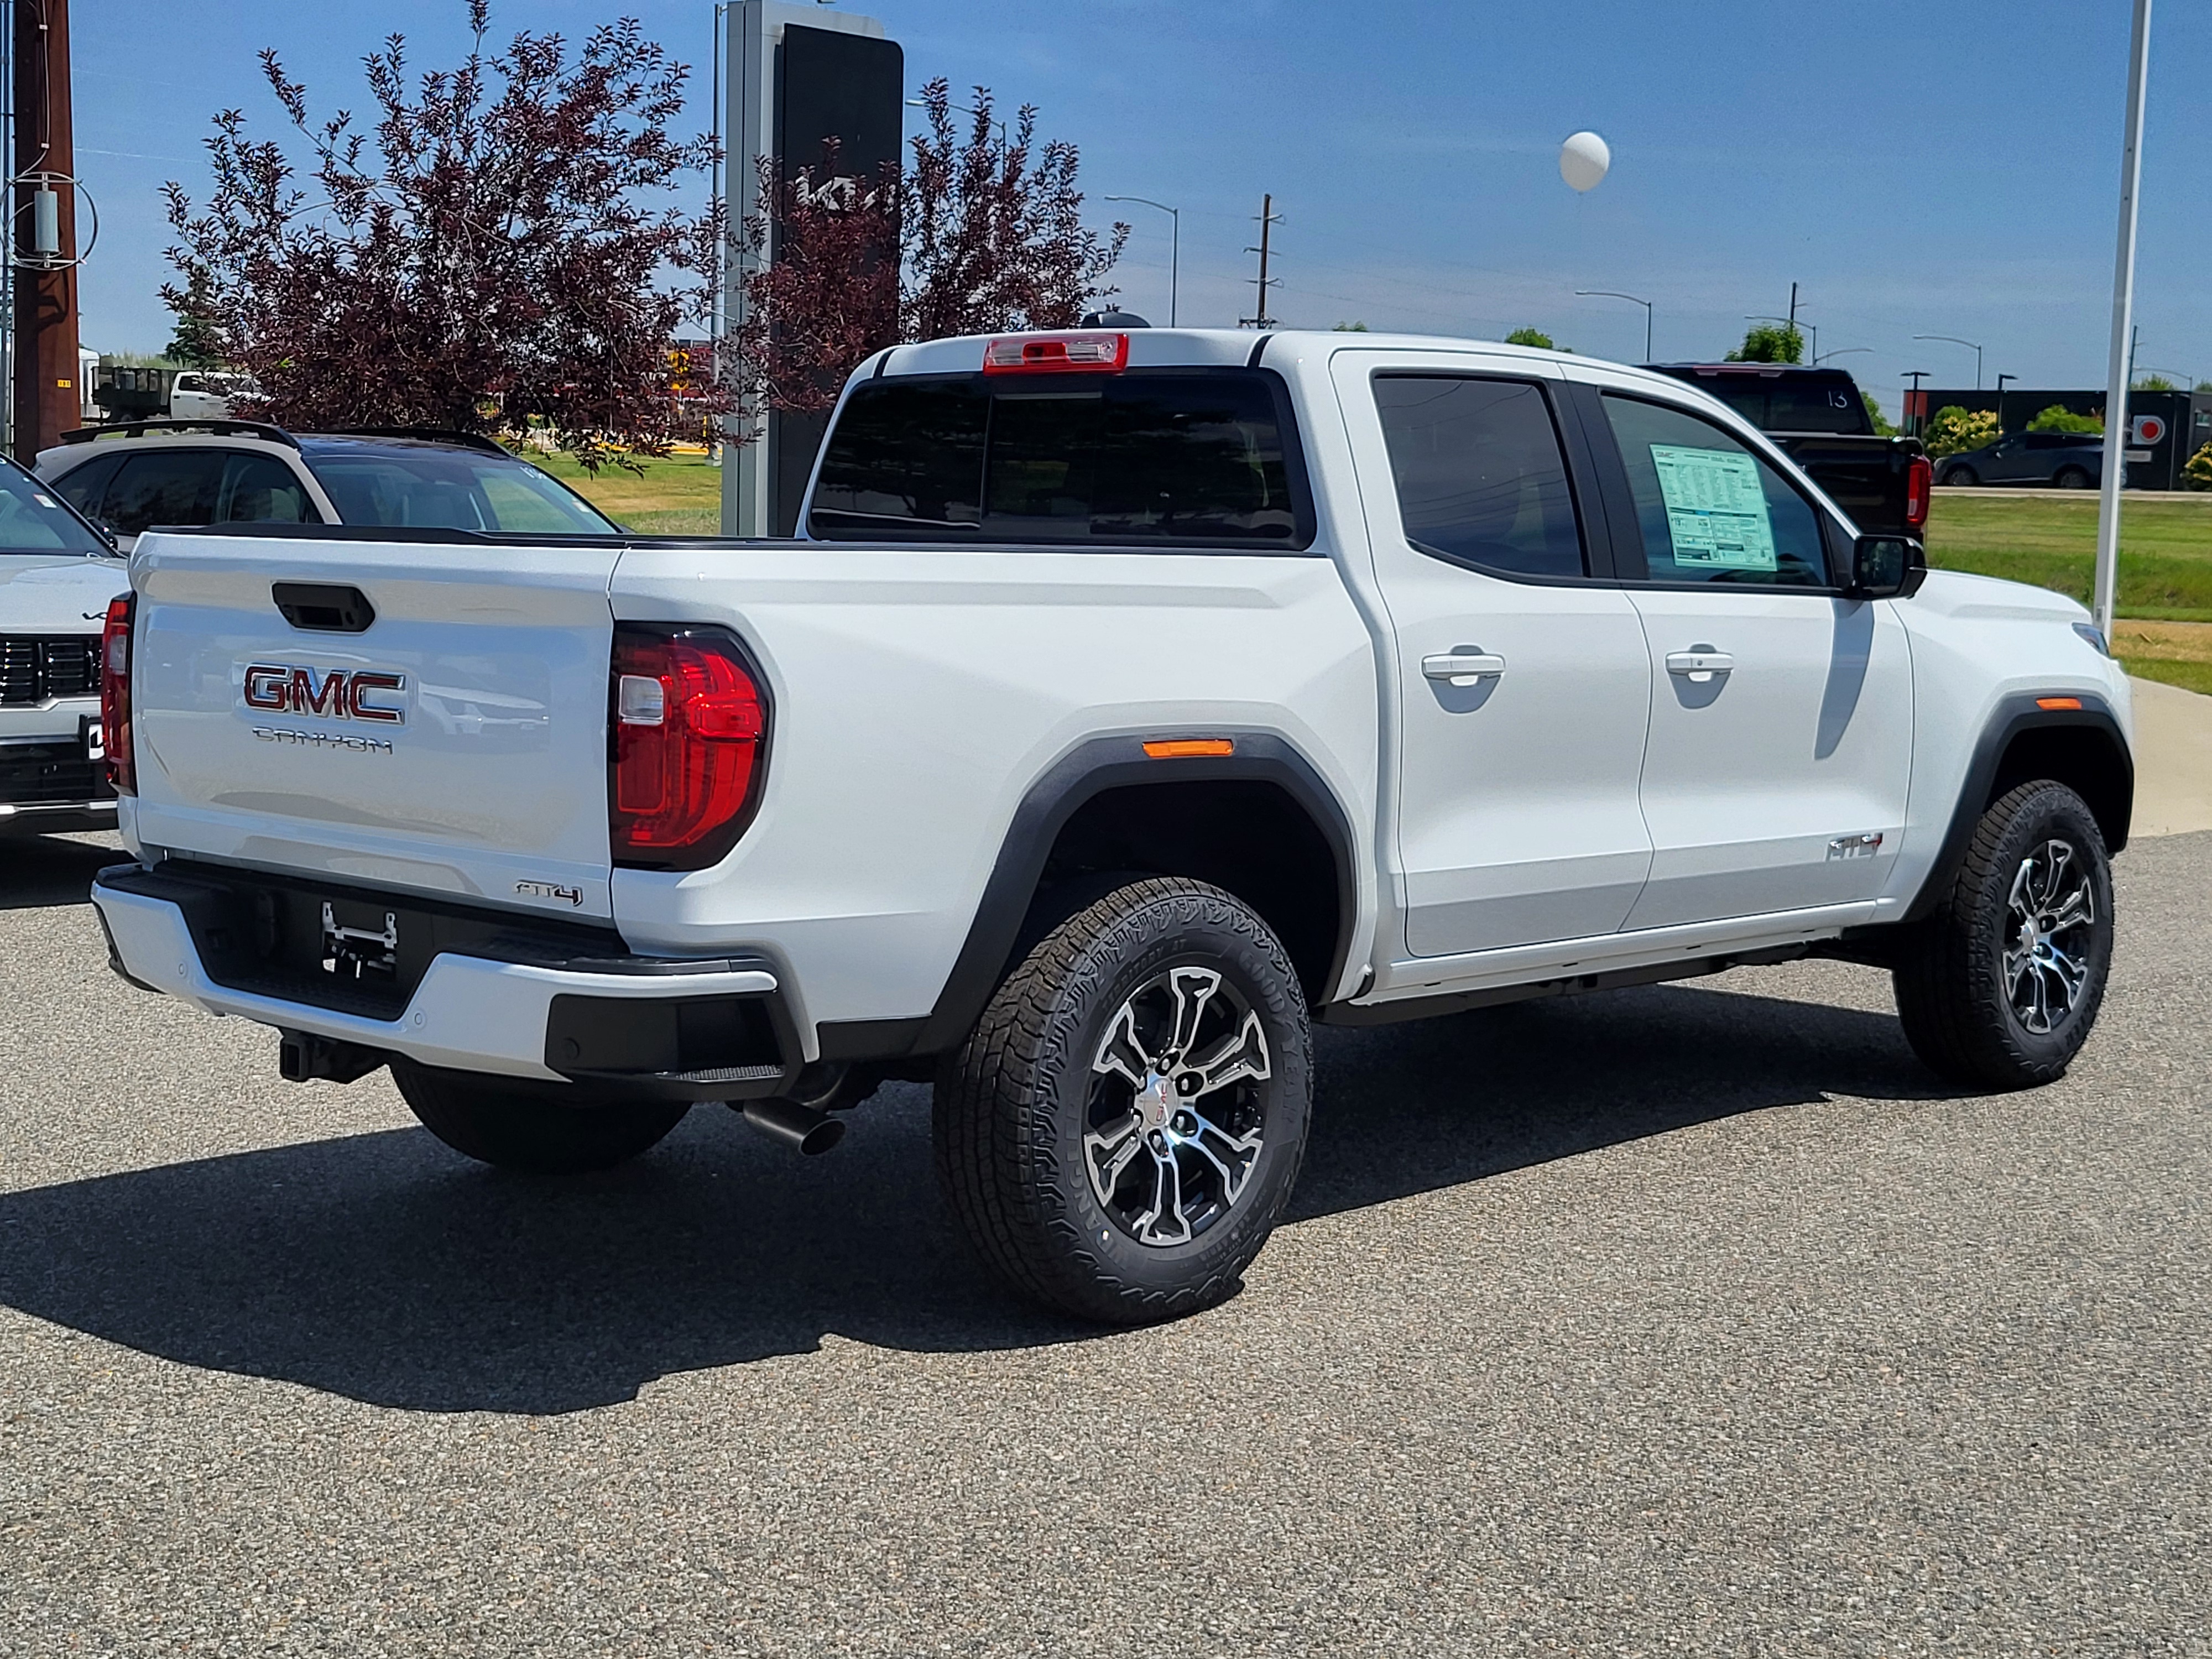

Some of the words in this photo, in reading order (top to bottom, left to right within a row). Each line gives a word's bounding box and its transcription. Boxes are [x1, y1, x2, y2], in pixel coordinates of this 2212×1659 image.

[1828, 390, 1847, 408] 13
[244, 662, 406, 726] GMC
[252, 726, 393, 754] CANYON
[1825, 832, 1883, 862] AT4
[514, 879, 583, 907] AT4
